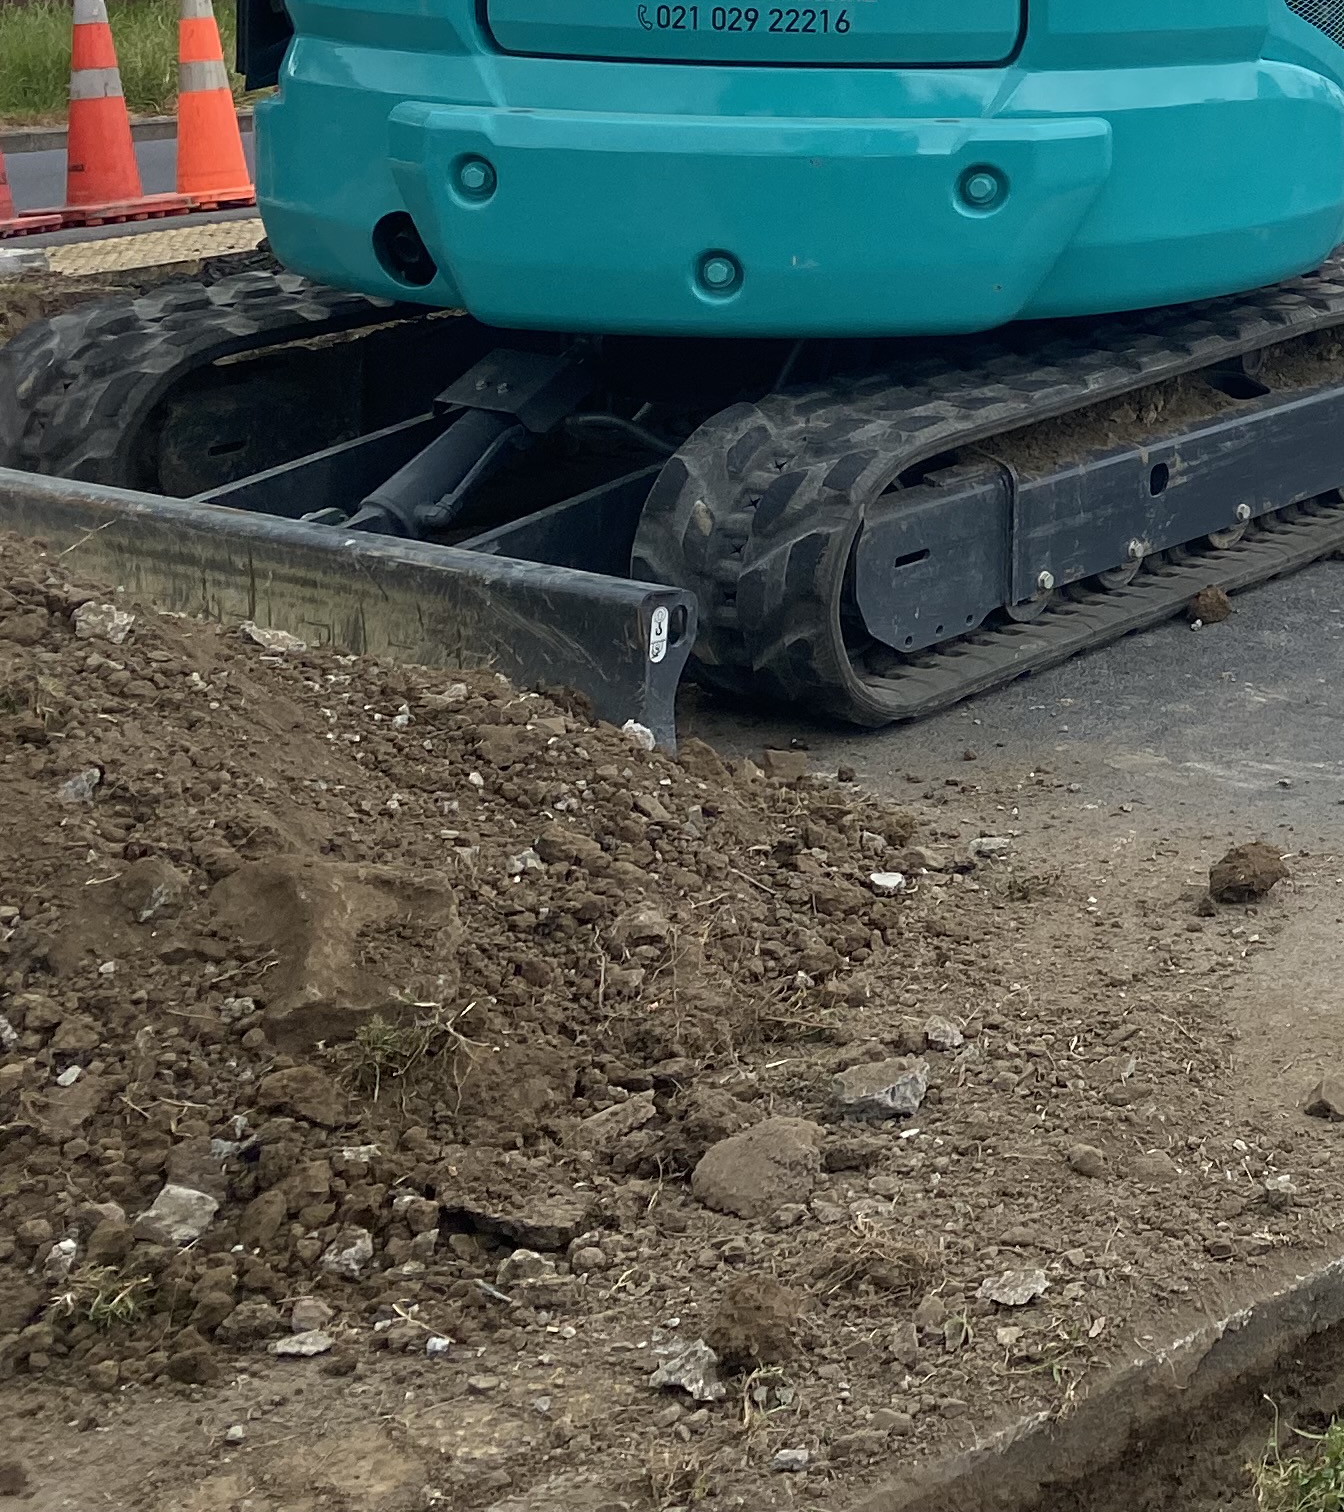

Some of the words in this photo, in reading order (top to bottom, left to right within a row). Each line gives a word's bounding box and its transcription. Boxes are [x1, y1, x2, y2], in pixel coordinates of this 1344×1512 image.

[656, 4, 699, 30] 021
[712, 6, 759, 32] 029
[768, 7, 851, 34] 22216
